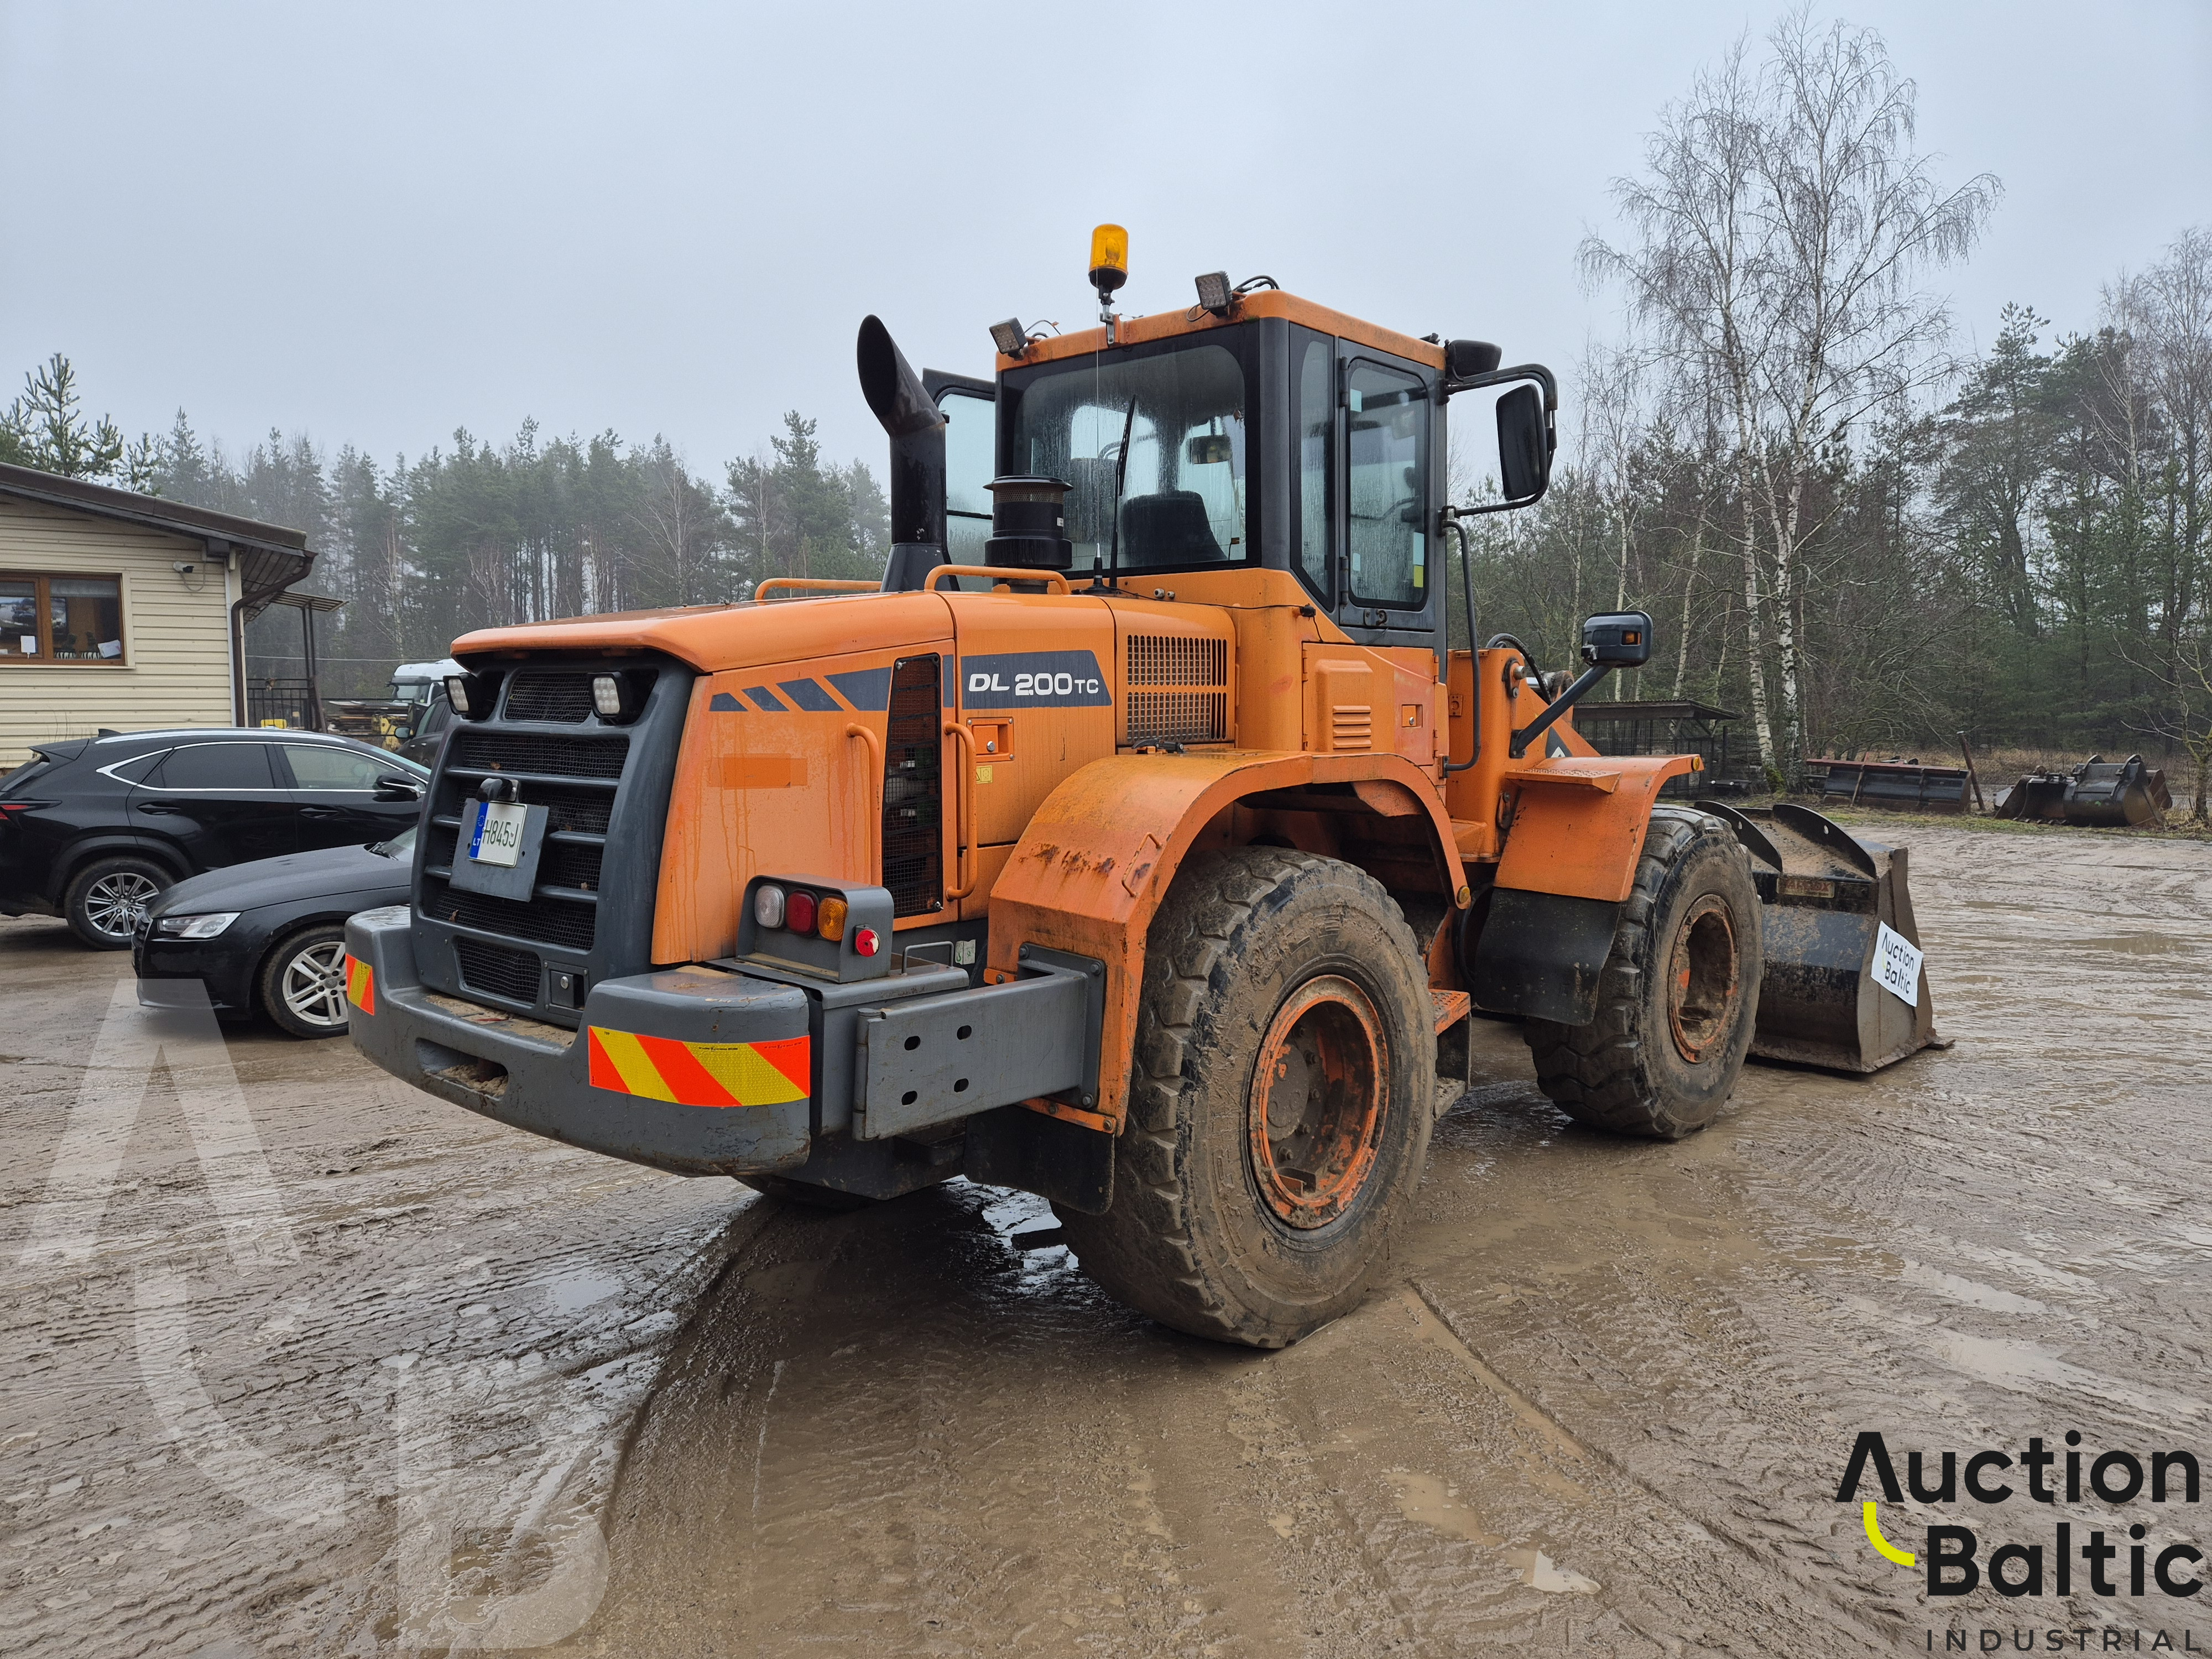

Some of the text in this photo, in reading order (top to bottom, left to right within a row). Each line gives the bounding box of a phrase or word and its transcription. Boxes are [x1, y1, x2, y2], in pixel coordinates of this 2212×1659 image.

[968, 673, 1010, 692] DL
[472, 837, 481, 846] LT
[482, 819, 519, 848] H845J
[1881, 932, 1914, 971] Auction
[1884, 960, 1911, 994] Baltic
